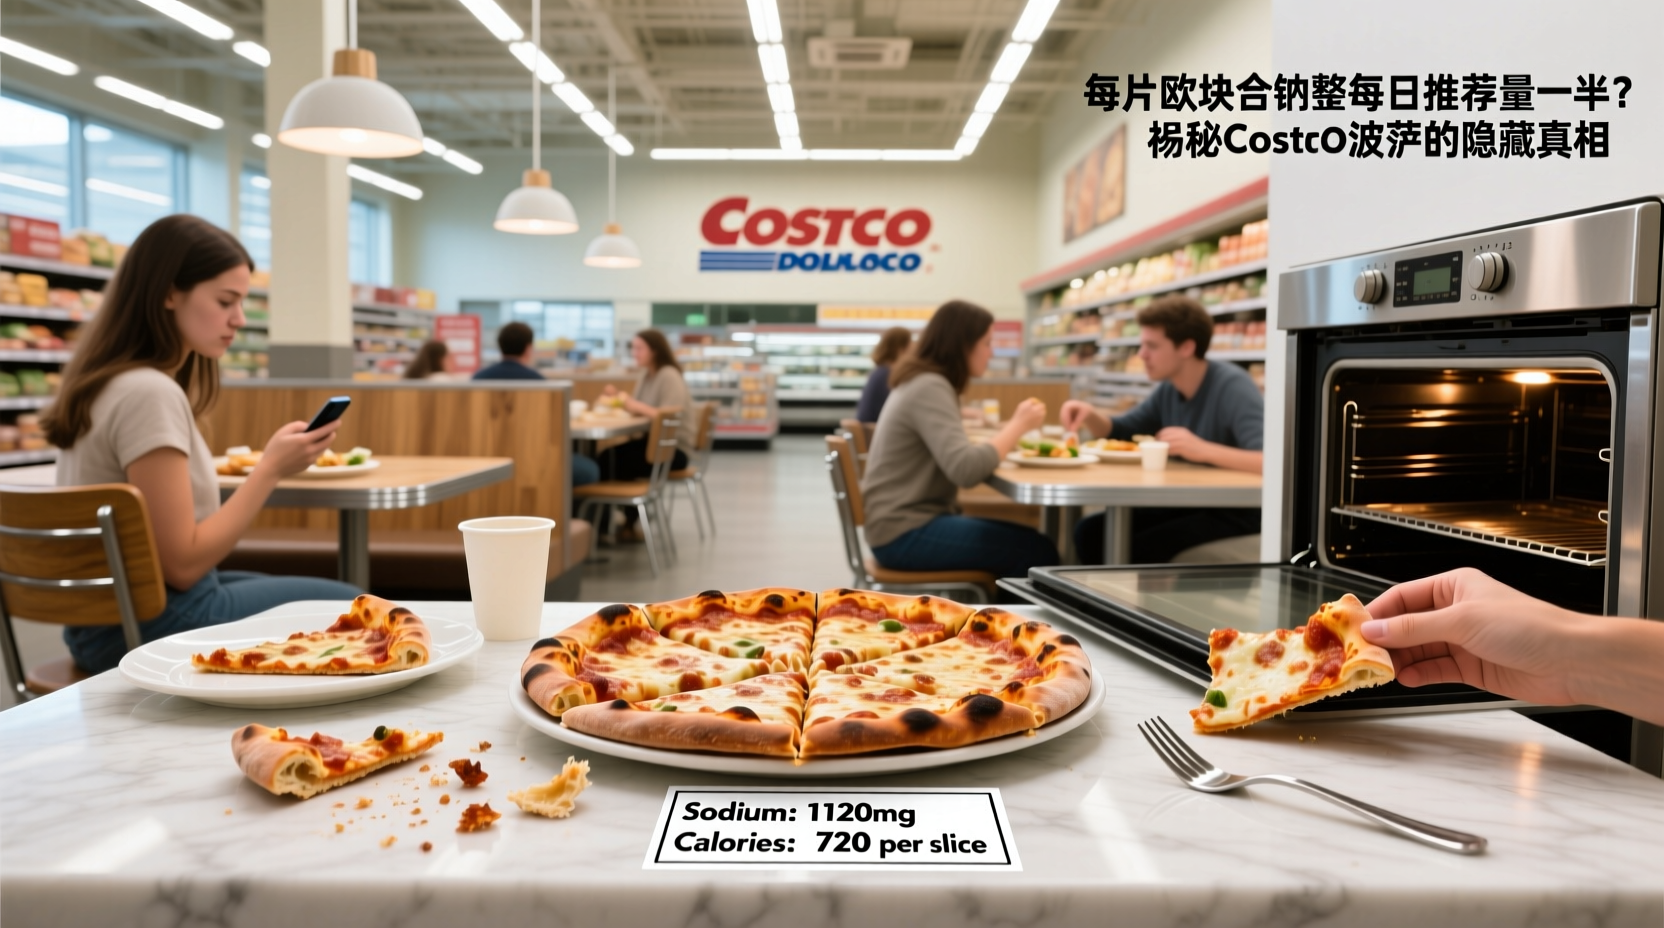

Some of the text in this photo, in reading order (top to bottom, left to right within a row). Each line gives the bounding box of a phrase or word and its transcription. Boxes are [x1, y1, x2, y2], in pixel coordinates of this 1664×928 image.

[682, 801, 916, 828] Sodium: 1120mg
[674, 831, 987, 859] Calories: 720 per slice
